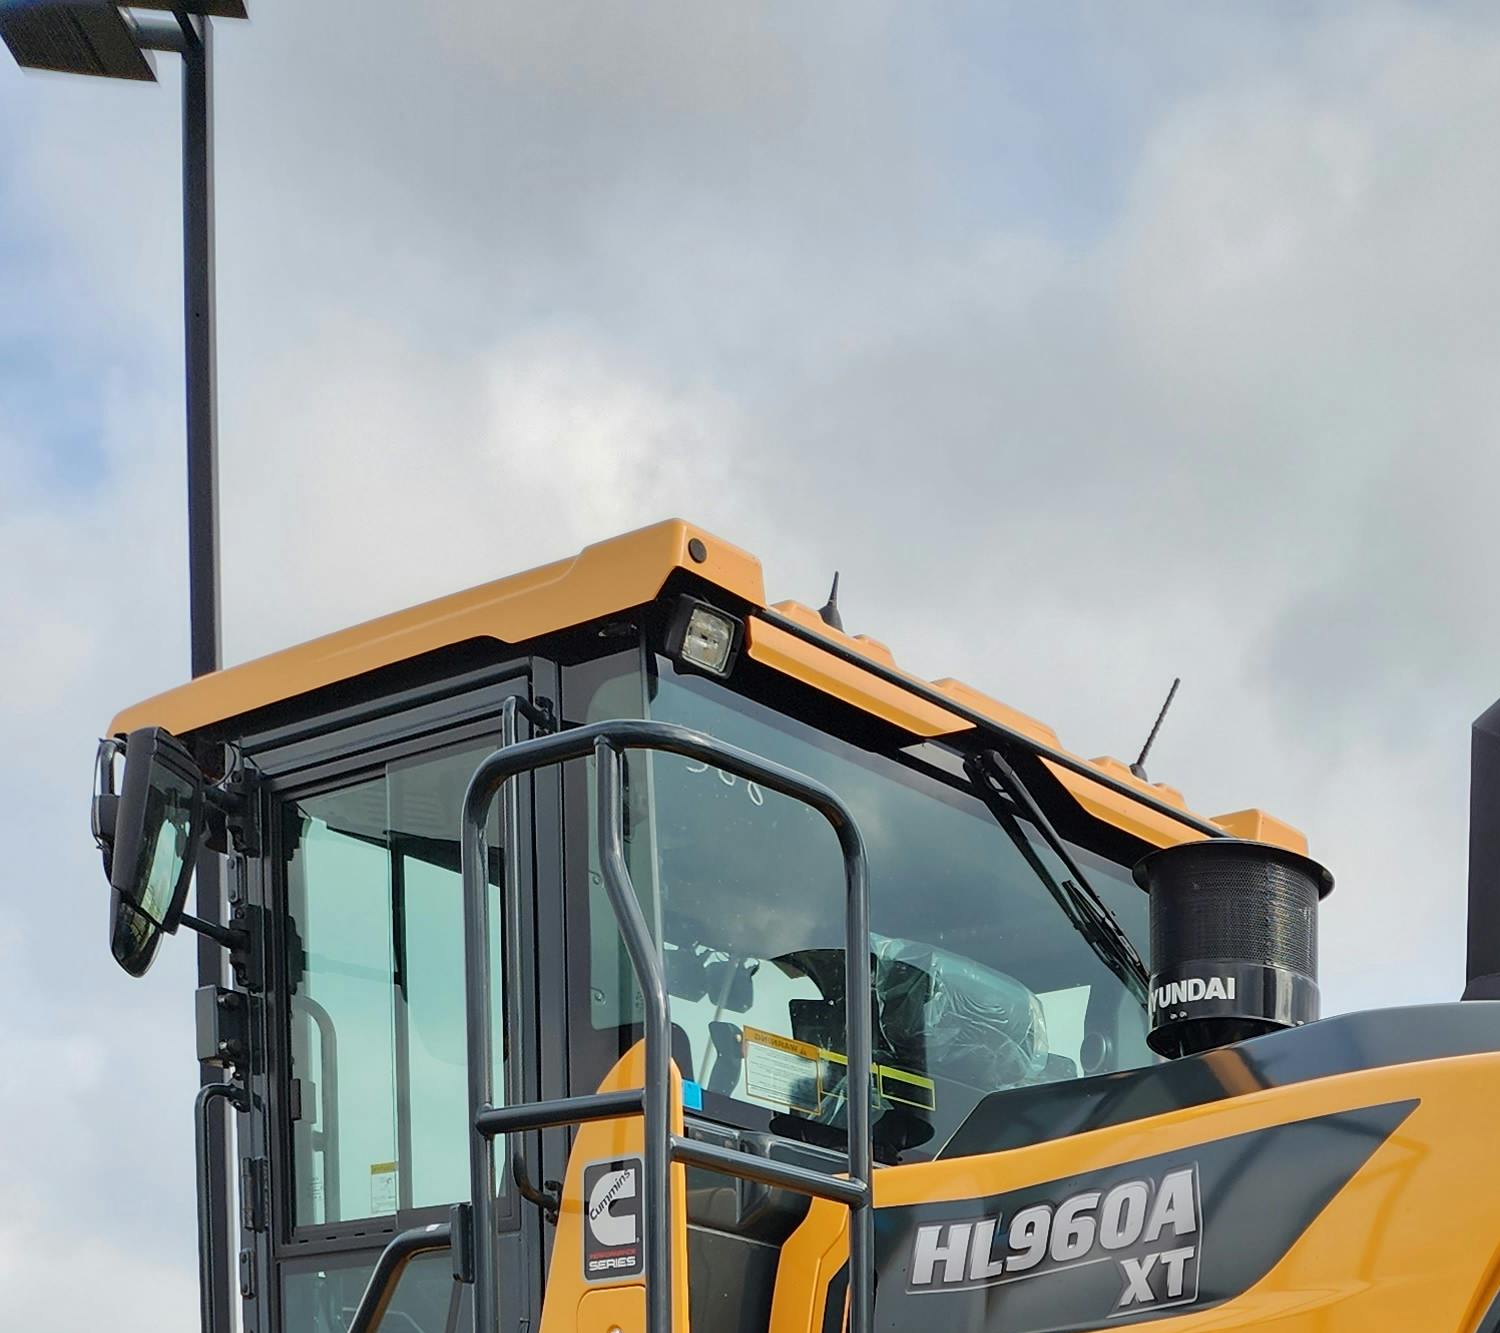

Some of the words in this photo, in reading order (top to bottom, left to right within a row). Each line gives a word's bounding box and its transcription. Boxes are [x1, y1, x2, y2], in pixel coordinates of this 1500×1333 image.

[1150, 977, 1235, 1013] YUNDAI
[589, 1168, 631, 1221] Cummins
[911, 1169, 1197, 1285] HL960A
[588, 1256, 636, 1272] SERIES
[1119, 1246, 1195, 1307] XT
